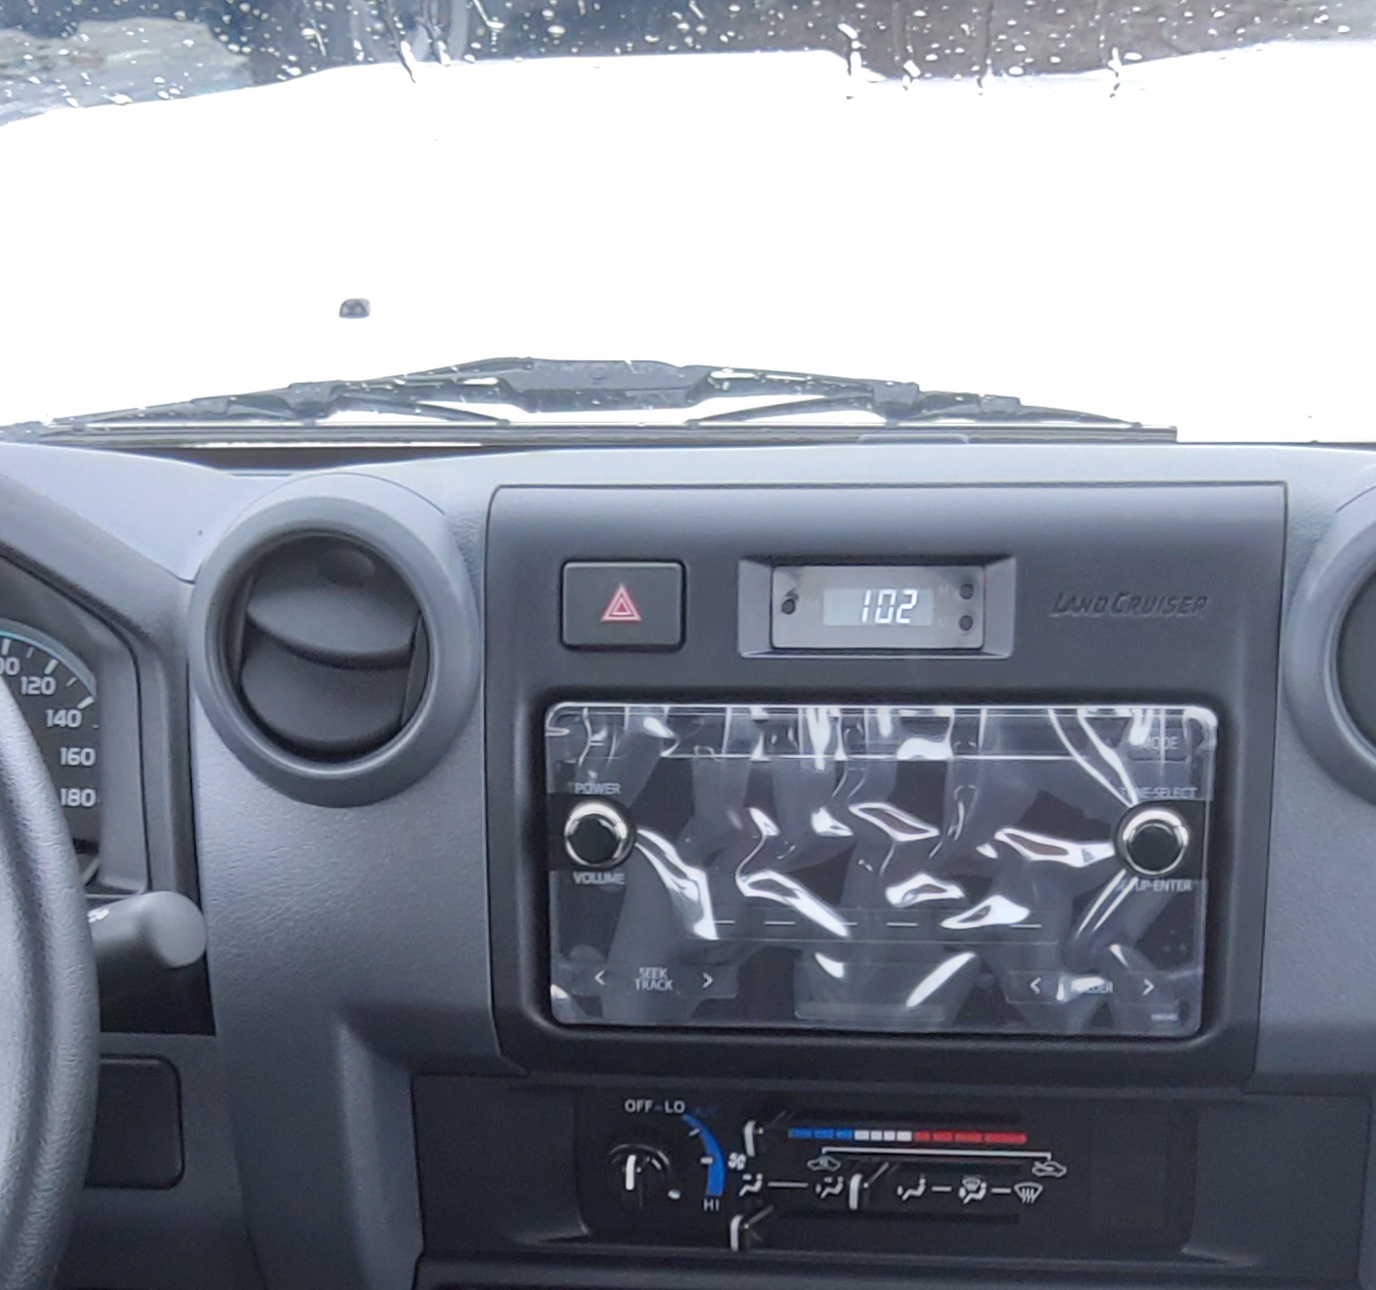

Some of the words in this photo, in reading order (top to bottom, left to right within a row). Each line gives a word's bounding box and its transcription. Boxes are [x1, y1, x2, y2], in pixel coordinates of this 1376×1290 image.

[20, 675, 57, 696] 120
[45, 708, 83, 729] 140
[60, 746, 97, 767] 160
[574, 782, 621, 795] POWER
[60, 787, 97, 808] 180
[573, 872, 625, 885] VOLUME
[638, 966, 668, 979] SEEK
[634, 978, 674, 992] TRACK
[703, 1198, 721, 1212] HI
